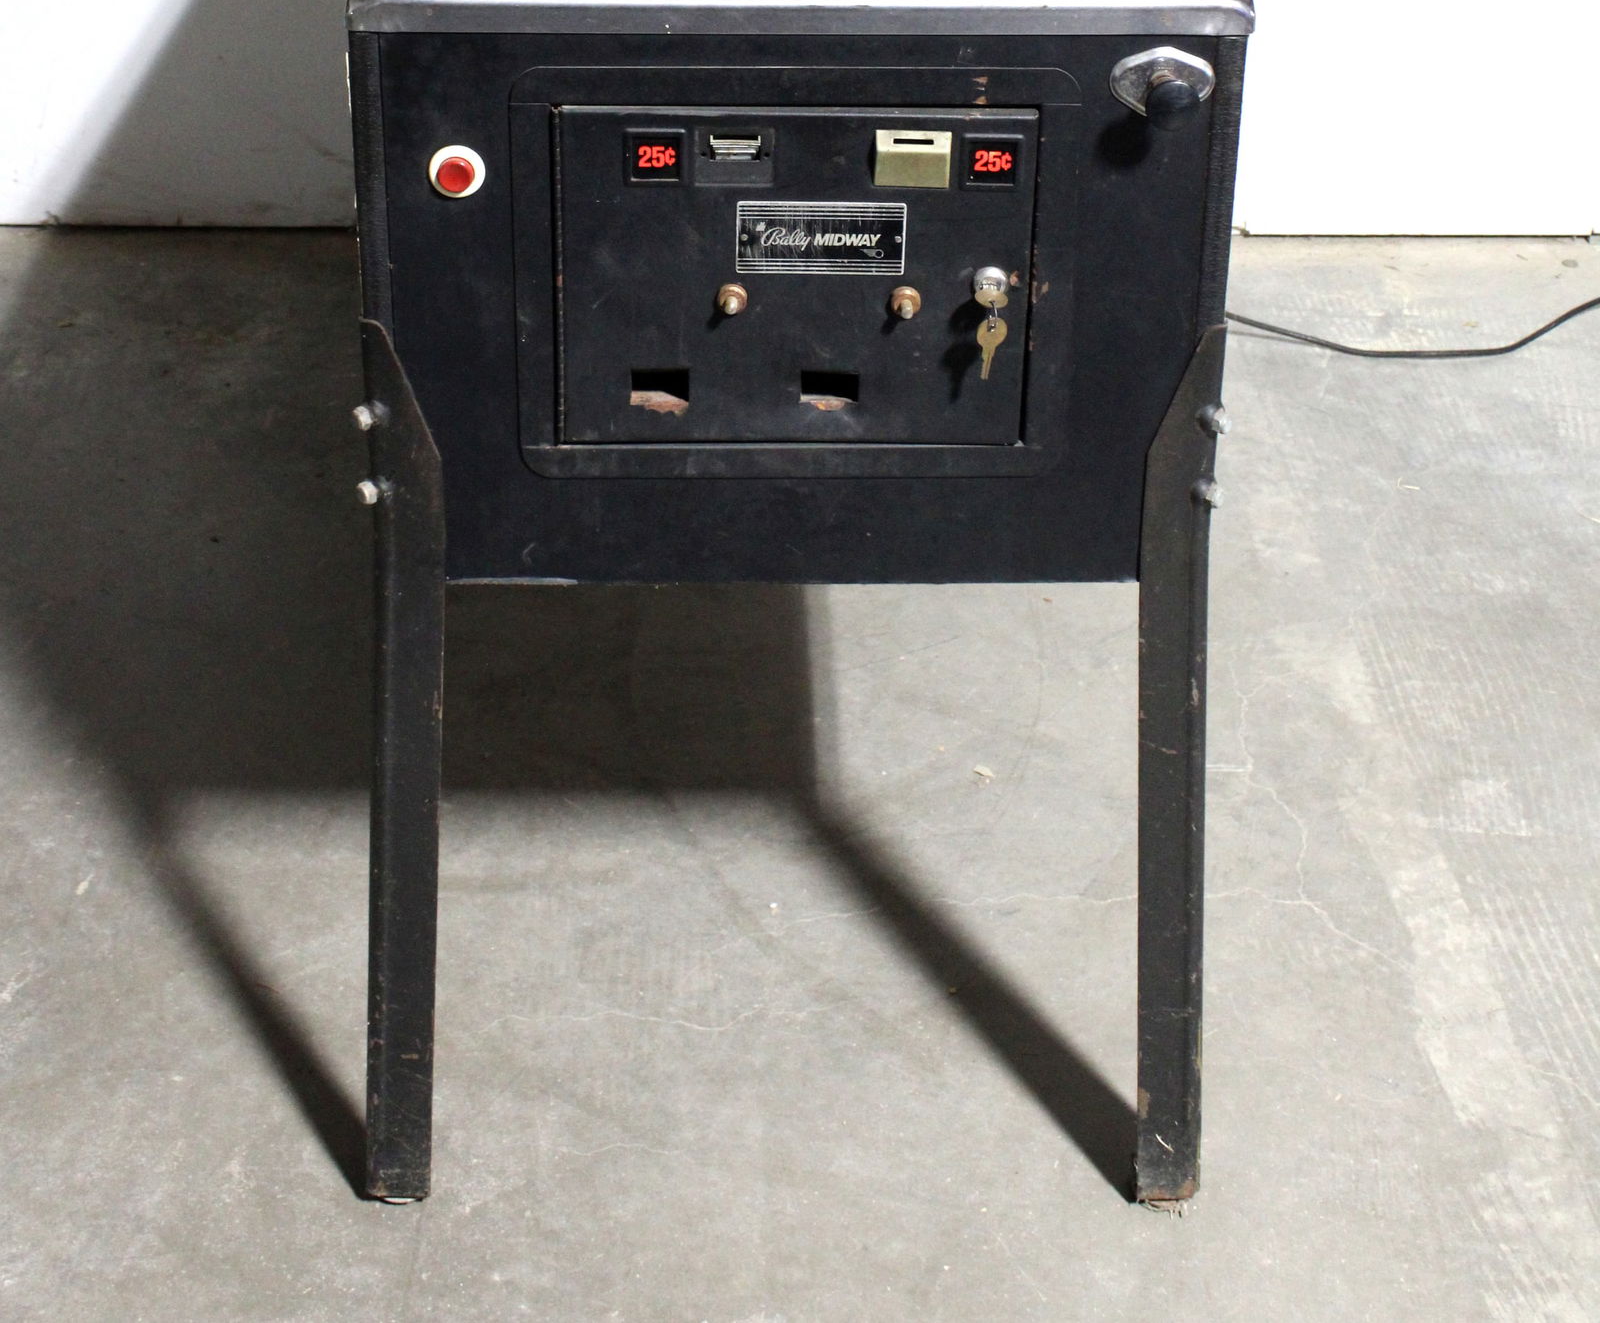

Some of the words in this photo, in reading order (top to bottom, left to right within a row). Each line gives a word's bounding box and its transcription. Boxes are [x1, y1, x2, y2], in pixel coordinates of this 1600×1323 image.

[638, 145, 676, 168] 25¢
[974, 150, 1012, 172] 25¢
[761, 227, 812, 252] Bally
[814, 233, 881, 247] MIDWAY
